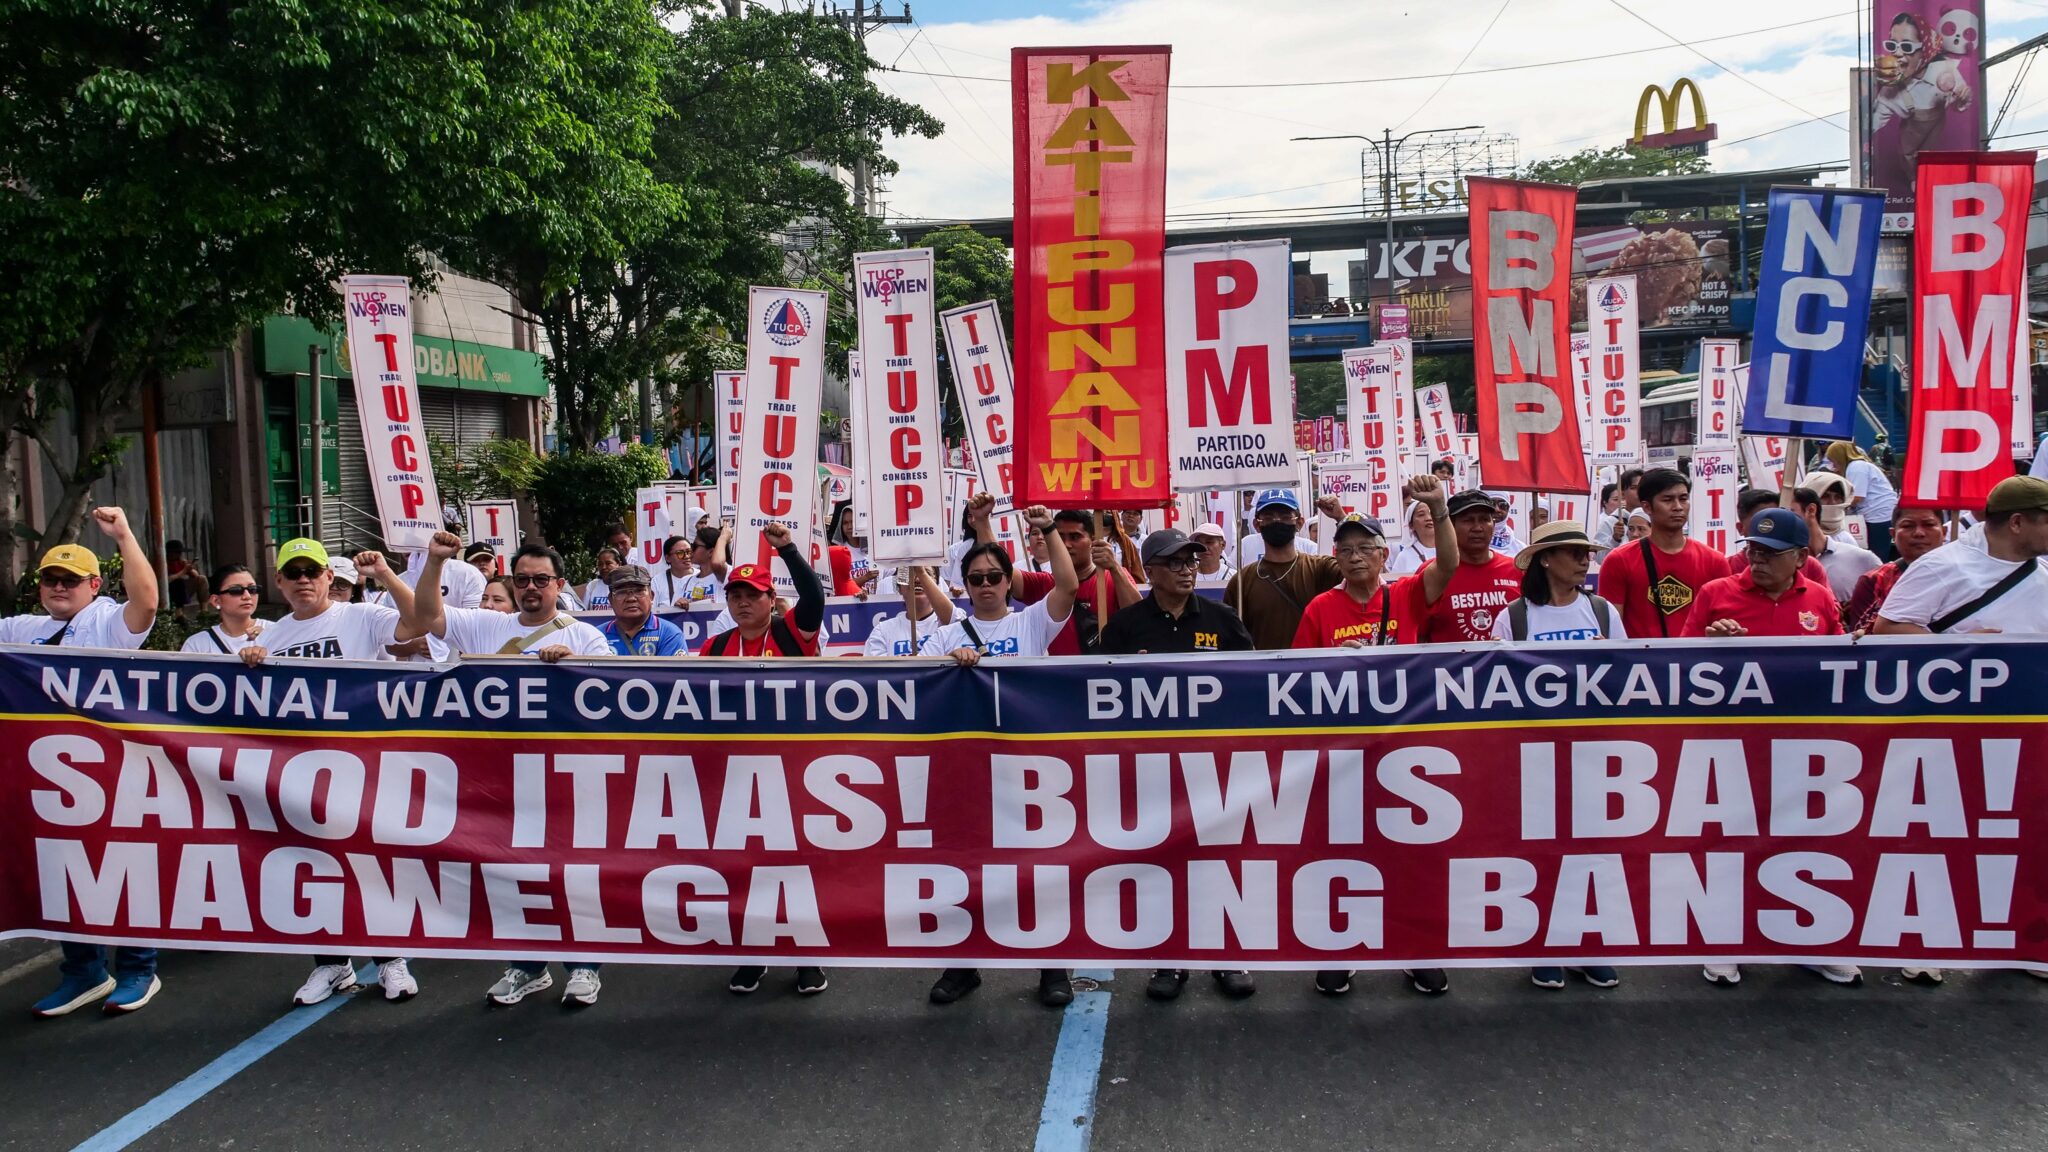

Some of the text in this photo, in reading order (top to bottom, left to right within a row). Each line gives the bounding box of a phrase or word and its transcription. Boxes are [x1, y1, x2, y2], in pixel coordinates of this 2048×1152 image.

[1043, 60, 1141, 459] KATIPUNAN
[867, 268, 904, 281] TUCP
[863, 278, 927, 298] WOMEN
[1702, 281, 1727, 290] HOT &
[352, 292, 387, 302] TUCP
[1700, 290, 1728, 299] CRISPY
[351, 302, 406, 318] WOMEN
[1668, 304, 1729, 315] KFC PH App
[1764, 199, 1863, 424] NCL
[1408, 307, 1451, 326] UTTER
[773, 322, 801, 333] TUCP
[1488, 210, 1563, 462] BMP
[1917, 182, 2013, 500] BMP
[1185, 258, 1272, 429] PM
[967, 345, 989, 357] TRADE
[886, 358, 913, 367] TRADE
[1350, 358, 1375, 368] TUCP
[1348, 364, 1390, 378] WOMEN
[767, 402, 797, 412] TRADE
[978, 395, 1001, 407] UNION
[889, 415, 915, 424] UNION
[1197, 433, 1266, 453] PARTIDO
[764, 461, 792, 470] UNION
[1179, 453, 1289, 472] MANGGAGAWA
[1698, 456, 1721, 465] TUCP
[882, 472, 928, 481] CONGRESS
[1039, 459, 1155, 492] WFTU
[1695, 463, 1733, 478] WOMEN
[1325, 475, 1352, 485] TUCP
[1268, 489, 1287, 499] L.A.
[1322, 483, 1367, 494] WOMEN
[393, 521, 437, 530] PHILIPPINES
[881, 527, 934, 537] PHILIPPINES
[485, 538, 504, 546] TRADE
[1451, 591, 1507, 610] BESTANK
[1660, 597, 1682, 606] EANS
[1334, 623, 1373, 639] MAYO
[1195, 632, 1218, 647] PM
[42, 658, 2010, 721] NATIONAL WAGE COALITION BMP KMU NAGKAISA TUCP
[27, 734, 2021, 851] SAHOD ITAAS! BUWIS IBABA!
[35, 837, 2018, 951] MAGWELGA BUONG BANSA!
